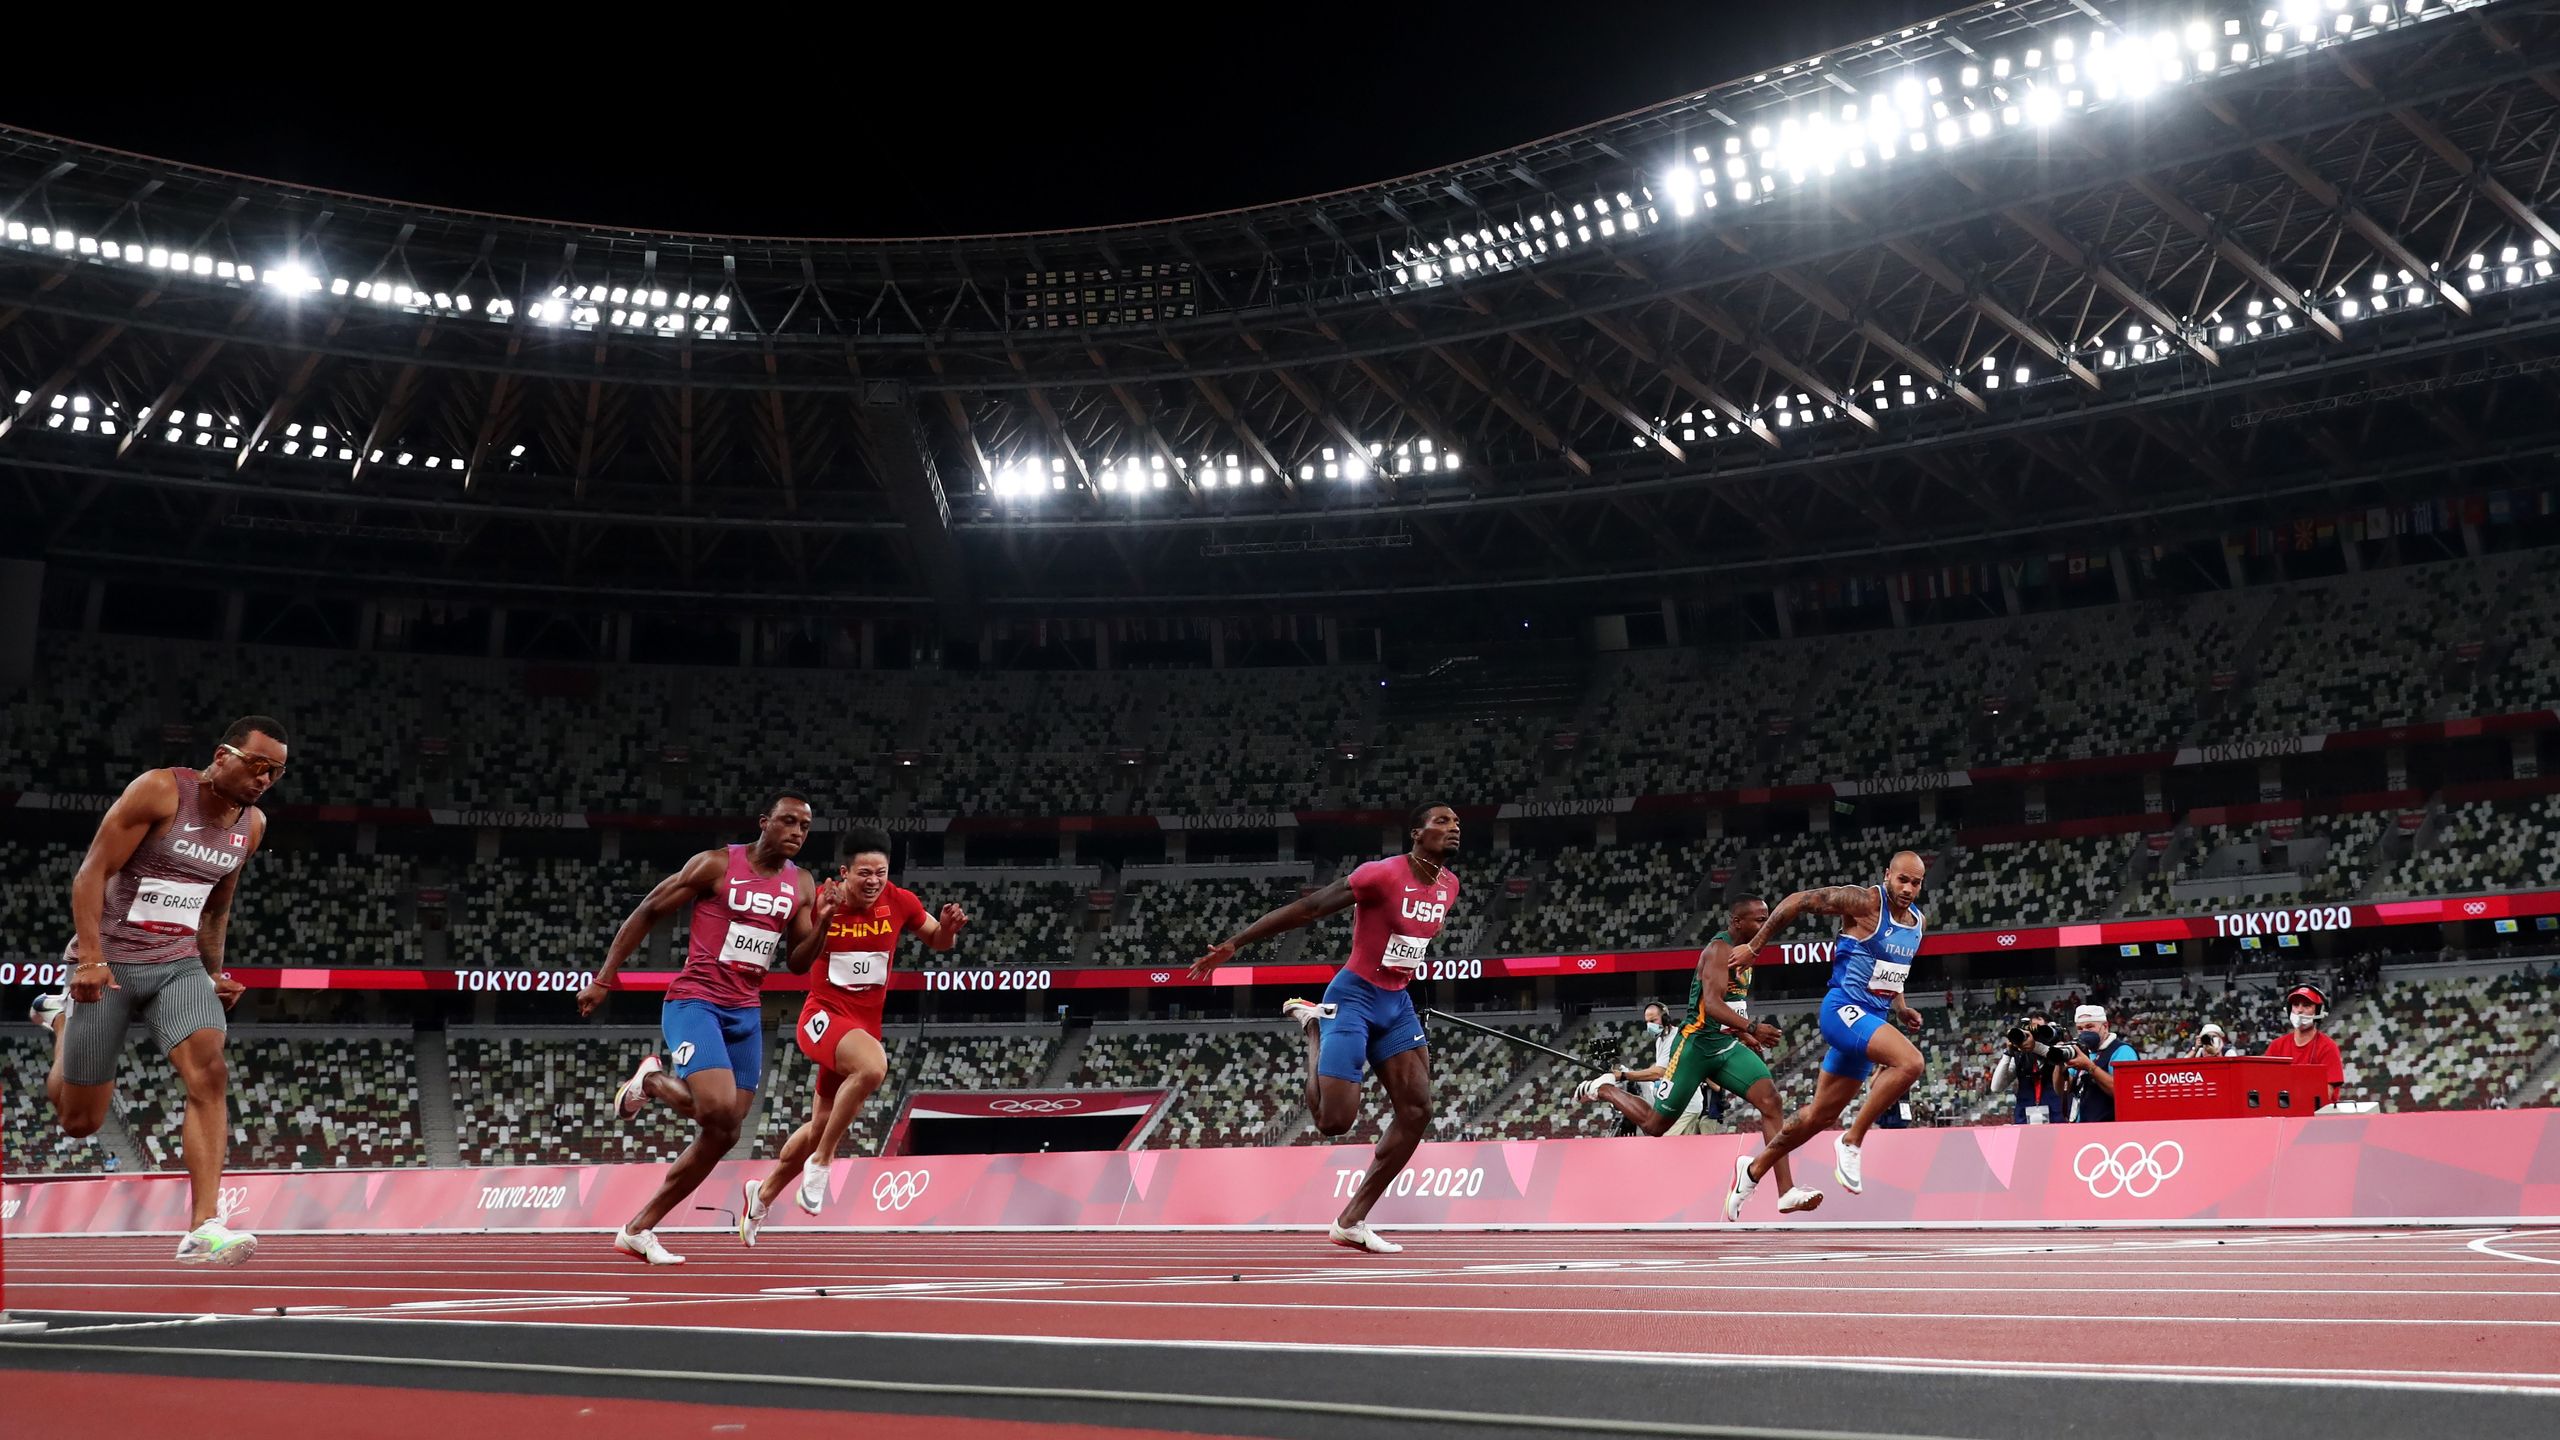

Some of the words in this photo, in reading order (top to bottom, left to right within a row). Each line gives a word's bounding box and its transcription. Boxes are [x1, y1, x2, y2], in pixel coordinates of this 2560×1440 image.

[2198, 741, 2255, 763] TOKYO
[2260, 737, 2302, 758] 2020
[1854, 776, 1907, 796] TOKYO
[1911, 772, 1950, 792] 2020
[456, 809, 516, 827] TOKYO
[520, 811, 563, 828] 2020
[1519, 800, 1572, 818] TOKYO
[1575, 798, 1614, 815] 2020
[887, 816, 928, 832] 2020
[1180, 814, 1233, 830] TOKYO
[1238, 812, 1276, 829] 2020
[172, 838, 240, 871] CANADA
[141, 891, 159, 904] de
[163, 894, 204, 910] GRASSE
[728, 887, 794, 920] USA
[1401, 897, 1446, 924] USA
[2214, 910, 2291, 938] TOKYO
[2294, 906, 2352, 932] 2020
[1780, 941, 1836, 965] TOKY
[1885, 943, 1916, 958] ITALIA
[21, 963, 68, 986] 202
[852, 961, 871, 975] SU
[1432, 959, 1482, 980] 2020
[454, 970, 532, 991] TOKYO
[536, 971, 593, 992] 2020
[923, 970, 994, 991] TOKYO
[998, 970, 1051, 990] 2020
[1844, 1005, 1859, 1021] 3
[811, 1017, 826, 1036] 6
[2159, 1071, 2204, 1084] OMEGA
[1659, 1081, 1669, 1098] 2
[1415, 1167, 1484, 1197] 2020
[477, 1185, 526, 1209] TOKYO
[522, 1185, 567, 1208] 2020
